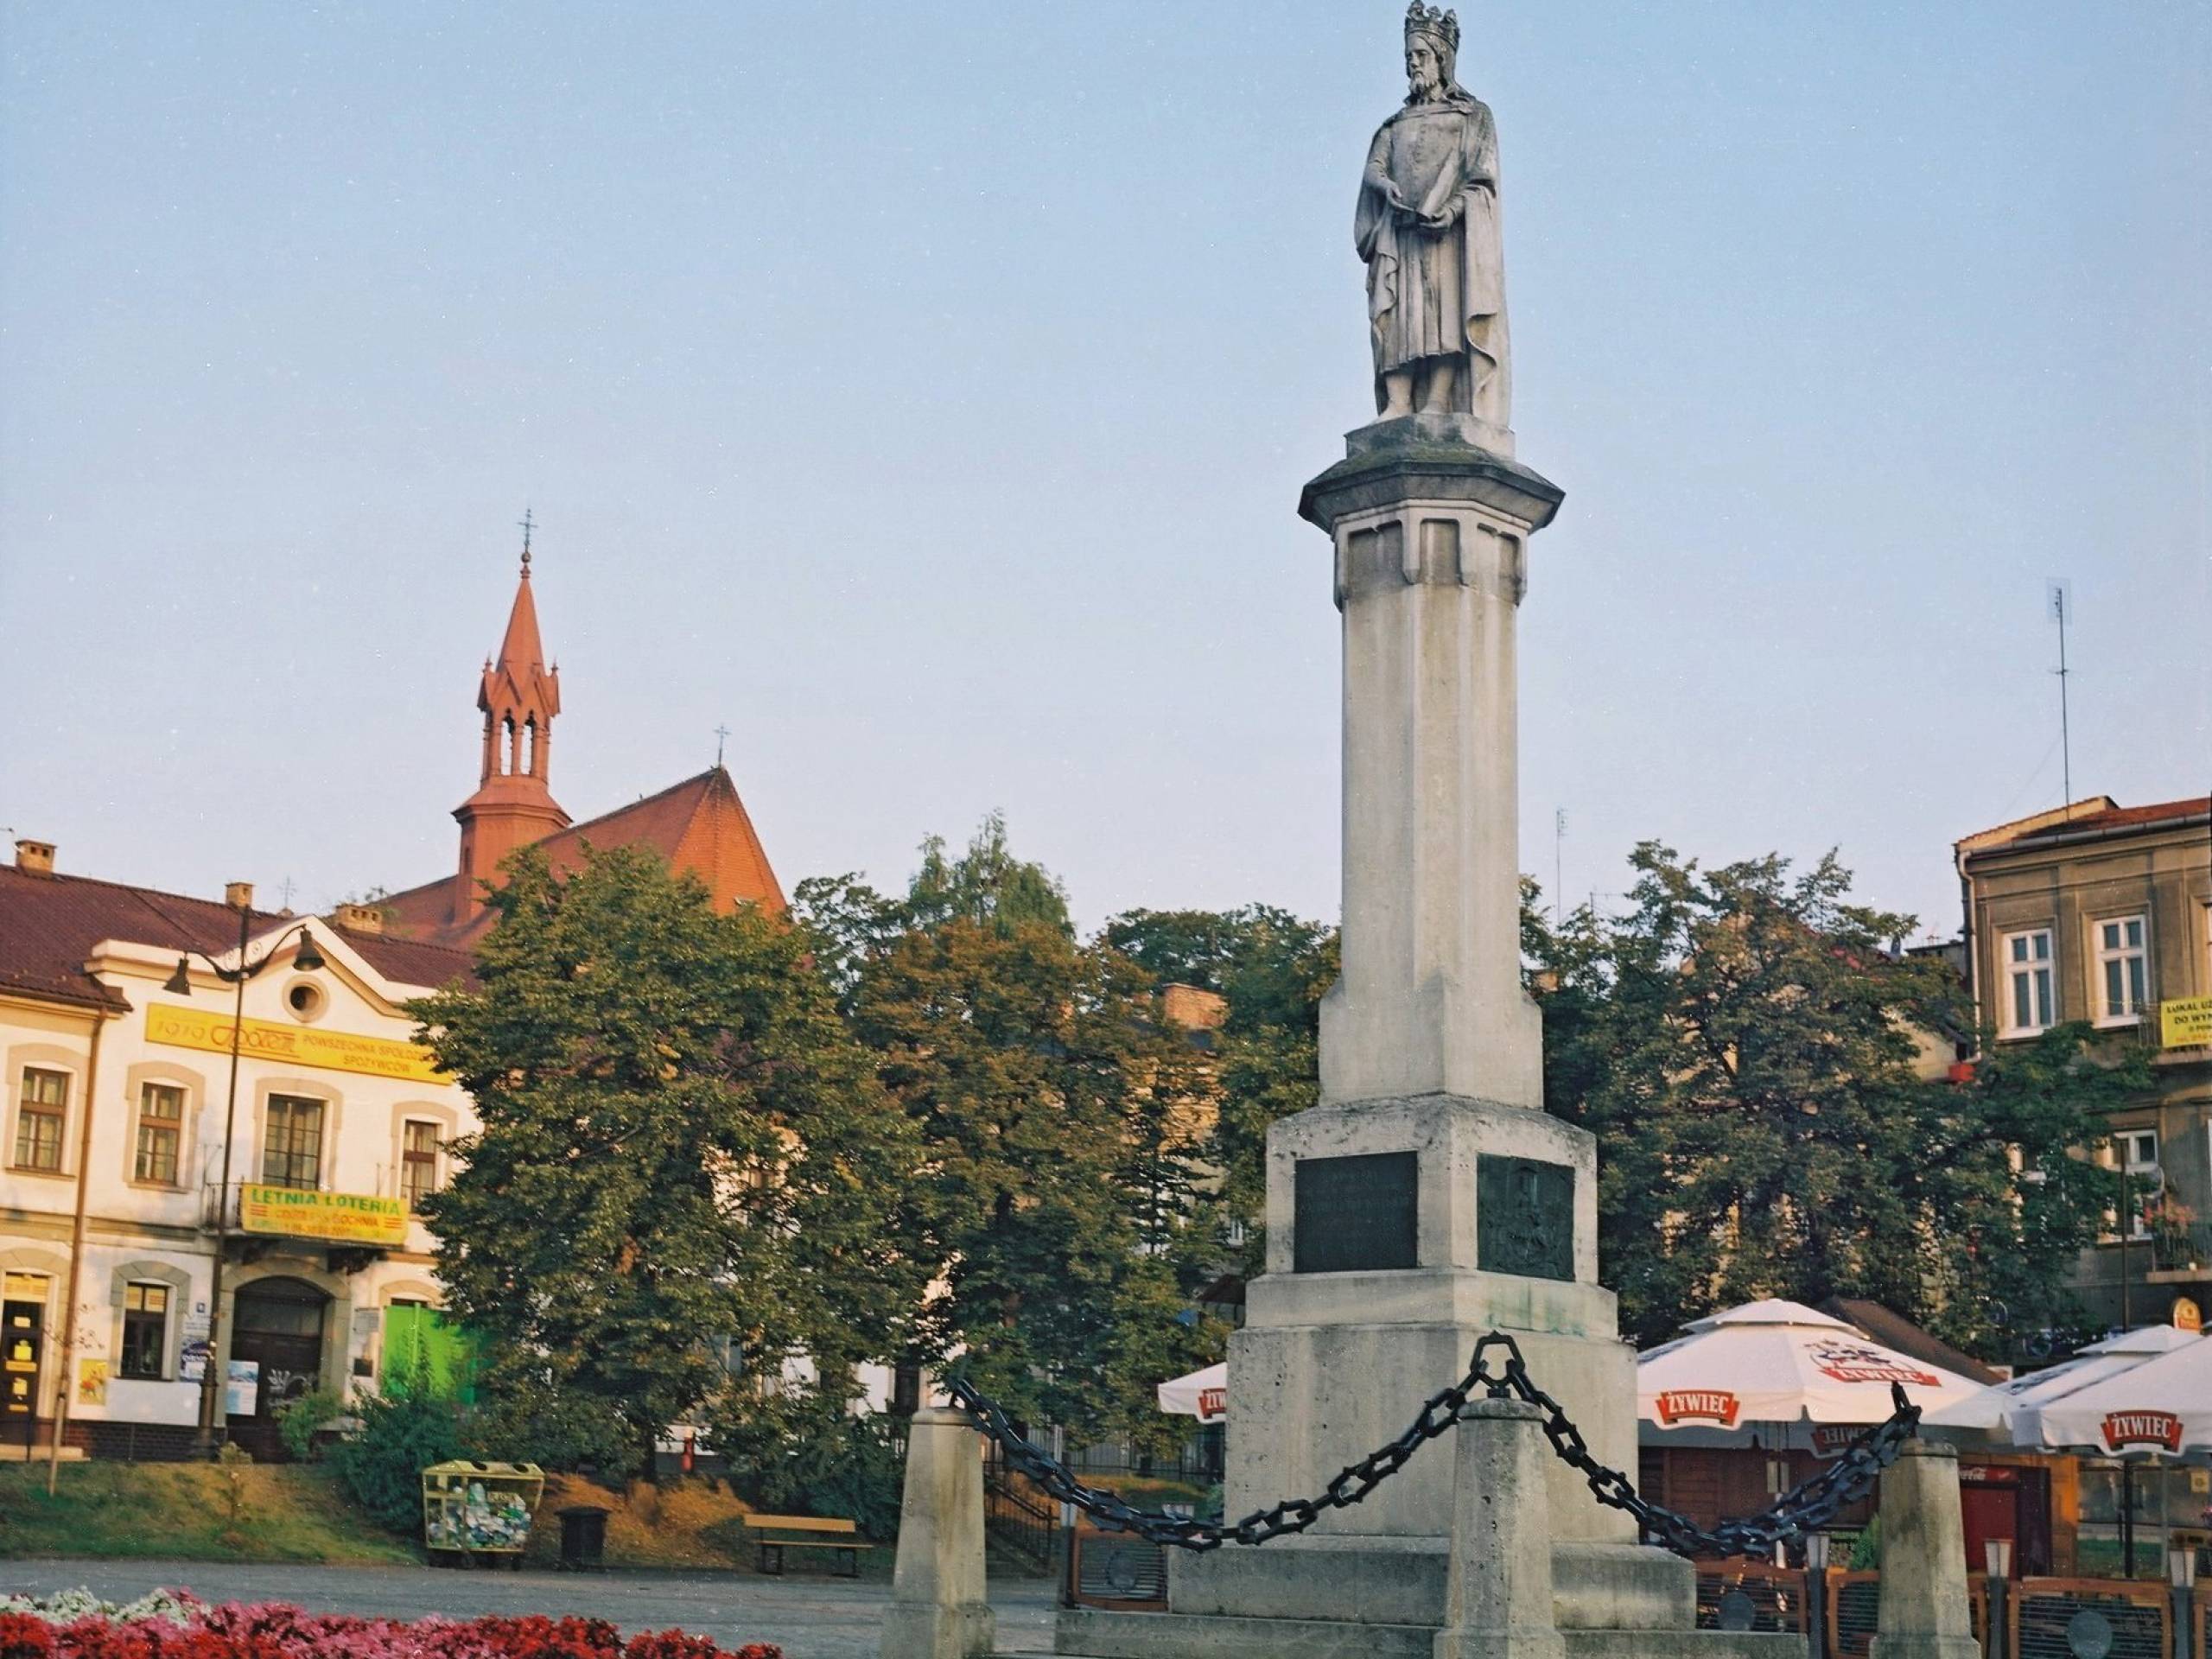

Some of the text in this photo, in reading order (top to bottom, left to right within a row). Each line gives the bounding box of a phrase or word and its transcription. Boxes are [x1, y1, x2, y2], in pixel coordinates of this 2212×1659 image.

[251, 1188, 317, 1205] LETNIA
[325, 1195, 401, 1216] LOTERIA
[1666, 1391, 1729, 1414] ŻYWIEC
[2111, 1414, 2172, 1438] ŻYWIEC
